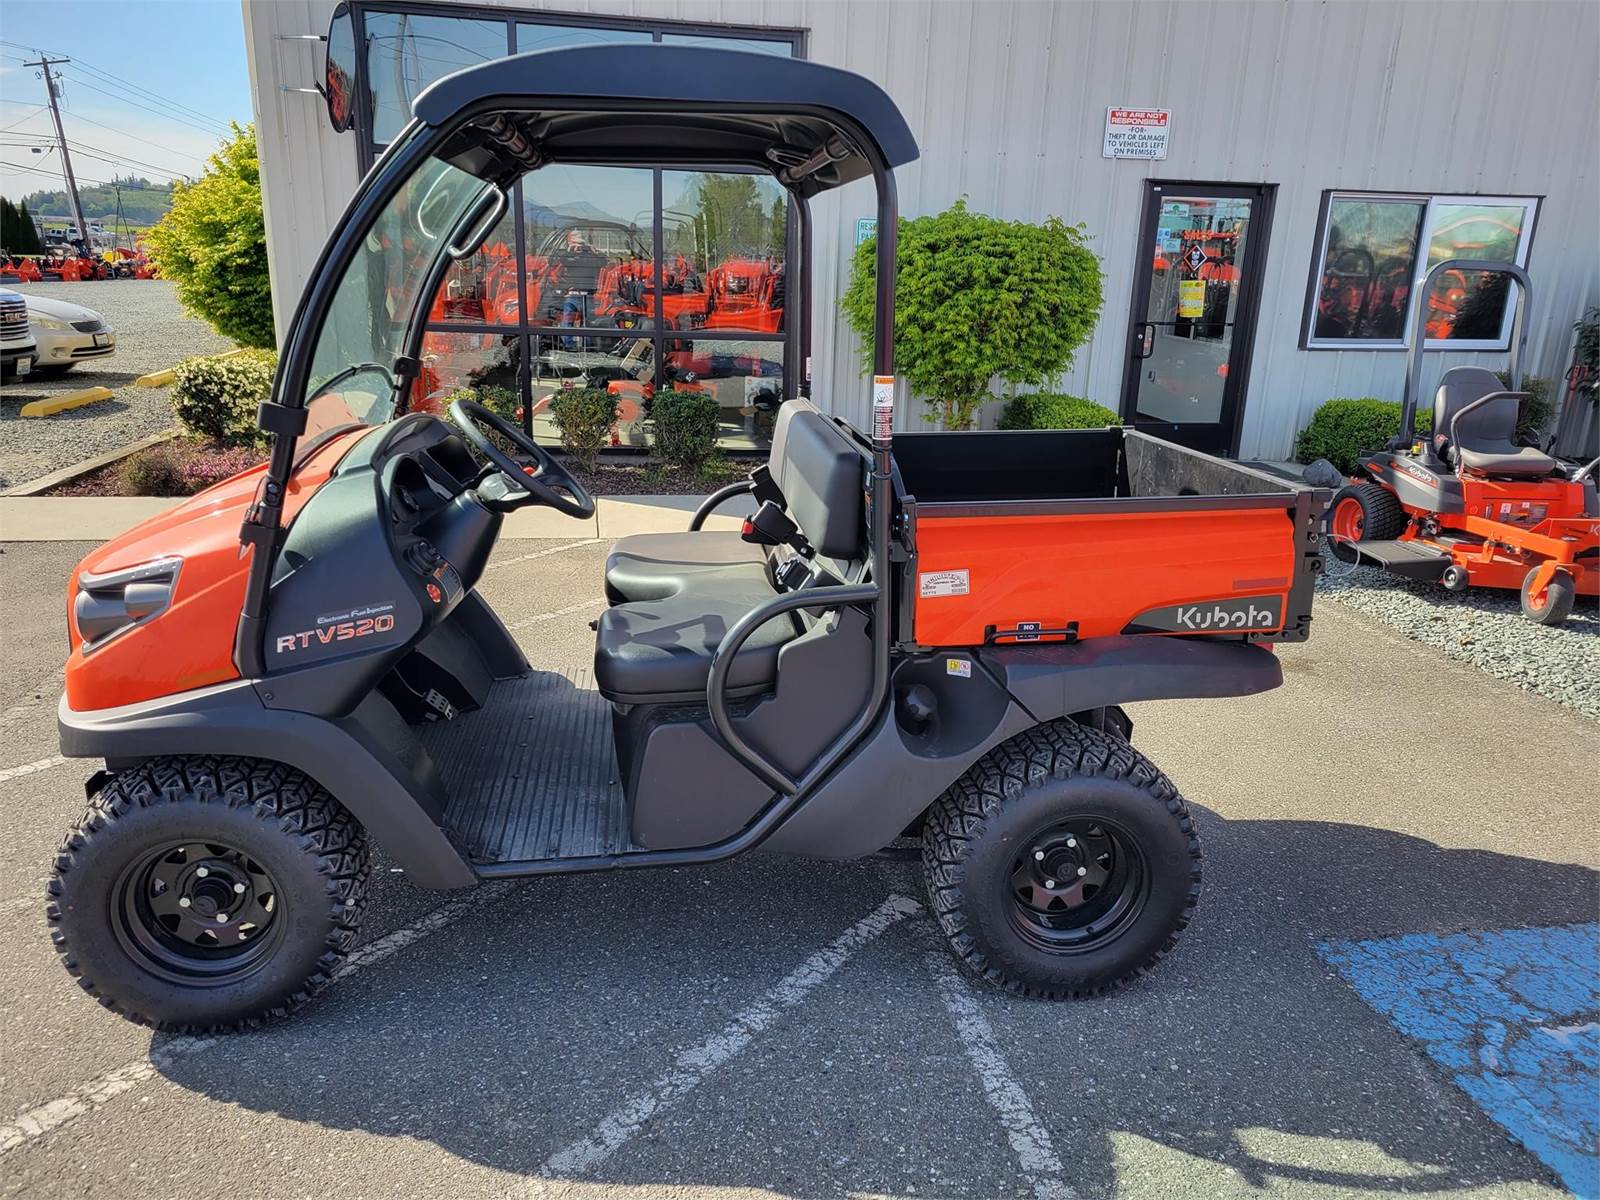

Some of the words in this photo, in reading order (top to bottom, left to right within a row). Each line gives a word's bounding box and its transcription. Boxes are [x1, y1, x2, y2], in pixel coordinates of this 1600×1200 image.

[1111, 117, 1166, 126] RESPONSIBLE
[1138, 134, 1166, 142] DAMAGE
[1408, 466, 1432, 482] Kubota
[1177, 605, 1273, 629] Kubota
[276, 614, 395, 653] RTV520
